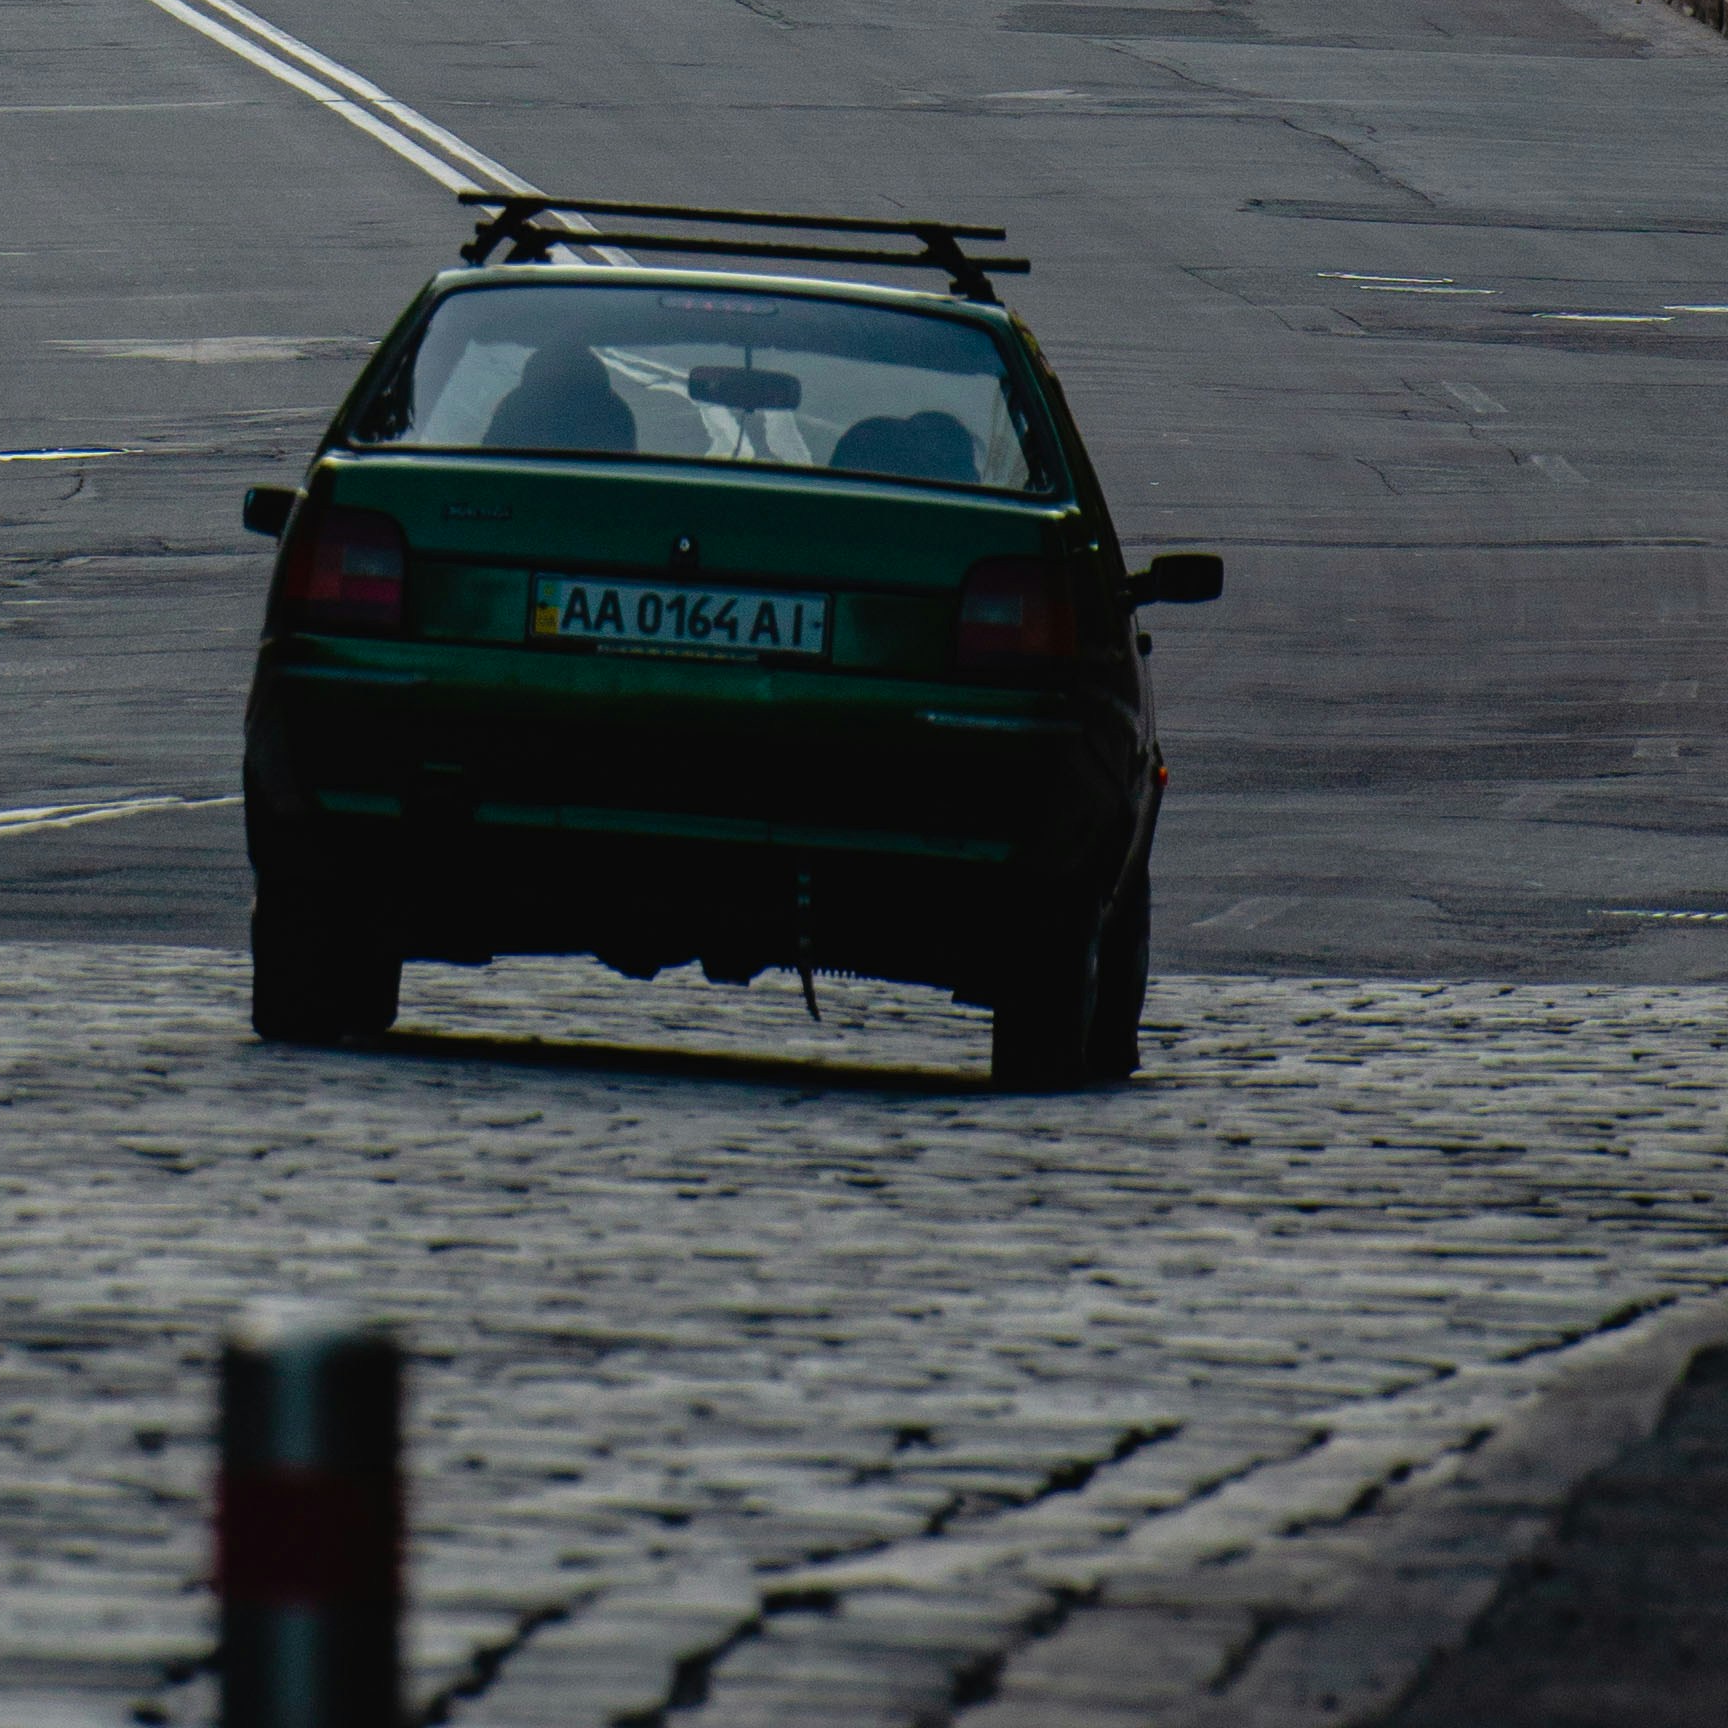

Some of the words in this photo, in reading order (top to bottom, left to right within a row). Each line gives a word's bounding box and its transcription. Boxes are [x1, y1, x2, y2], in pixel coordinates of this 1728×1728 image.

[562, 586, 625, 633] AA
[637, 592, 740, 641] 0164
[749, 600, 804, 645] AI
